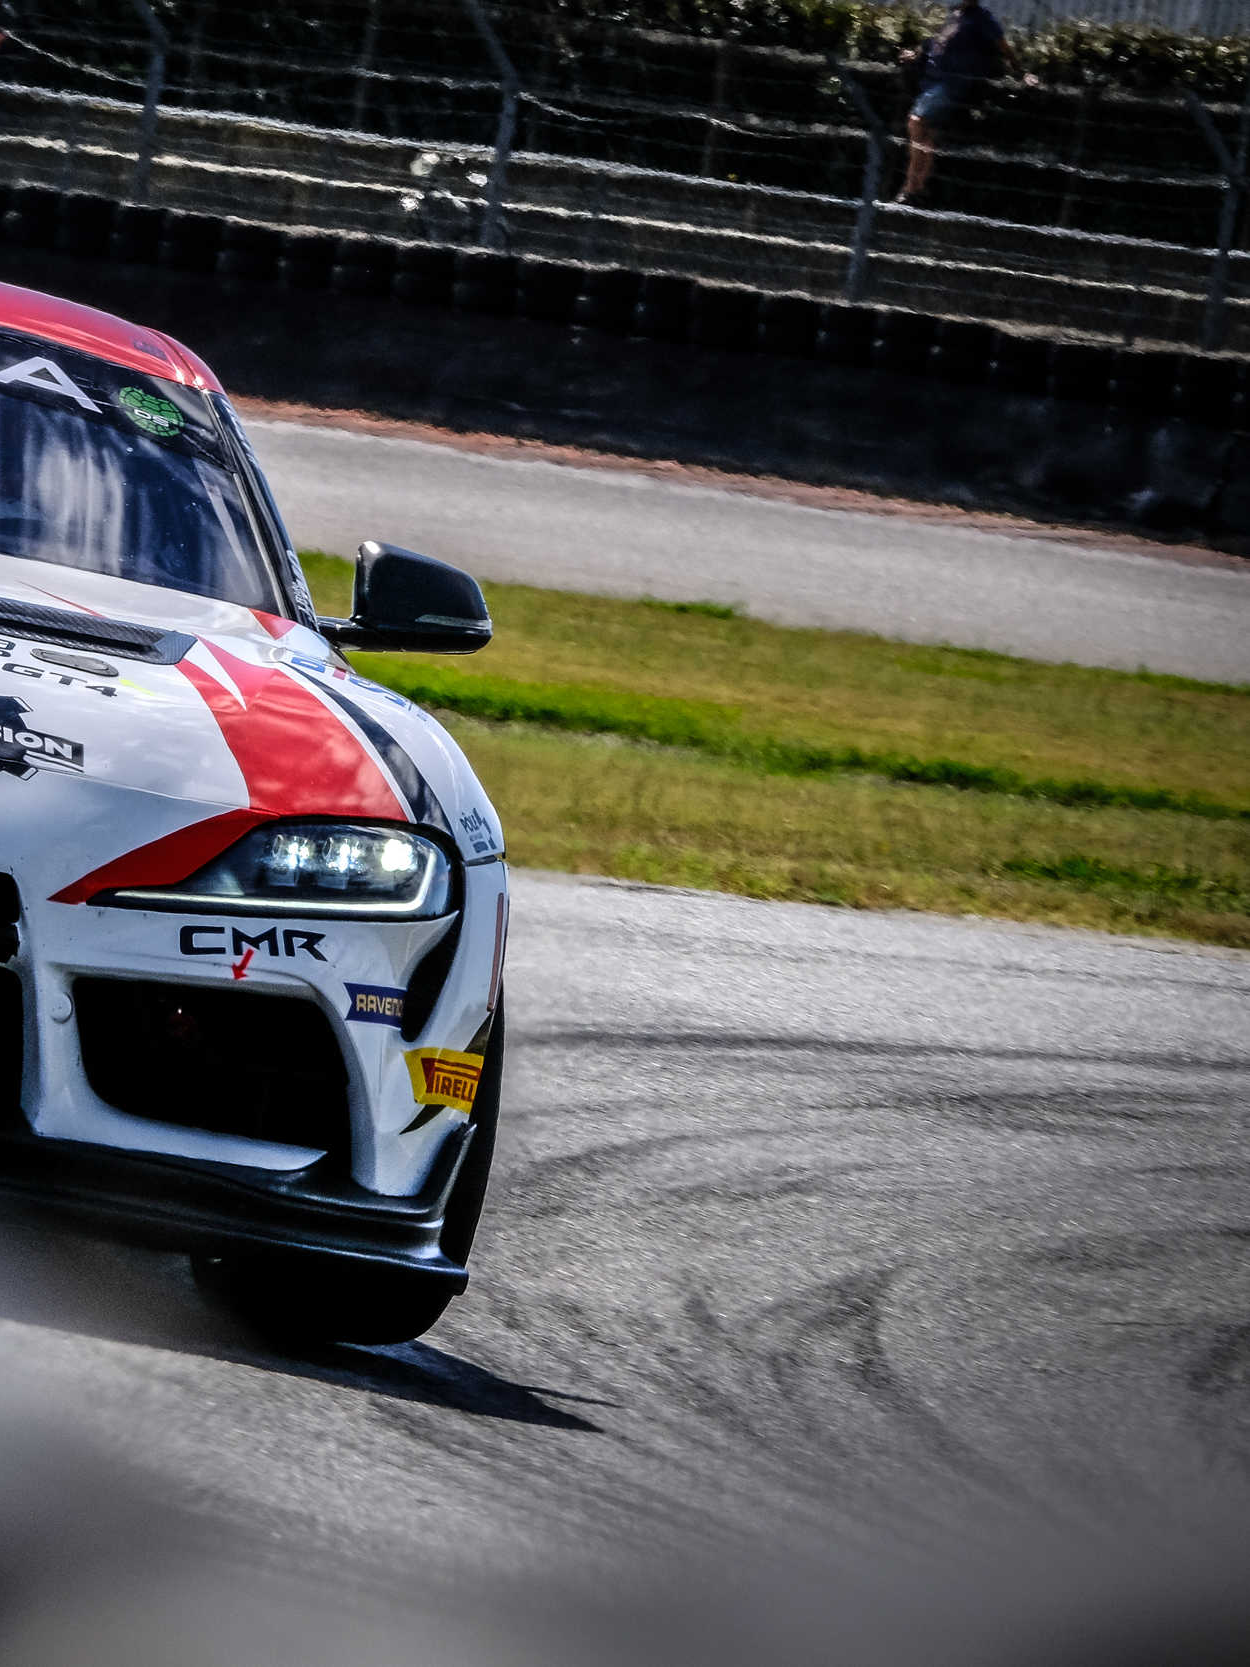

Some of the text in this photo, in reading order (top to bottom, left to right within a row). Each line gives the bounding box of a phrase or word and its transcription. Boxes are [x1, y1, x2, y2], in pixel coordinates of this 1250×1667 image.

[1, 662, 118, 698] GT4
[179, 925, 328, 962] CMR
[420, 1057, 482, 1103] PIRELL
